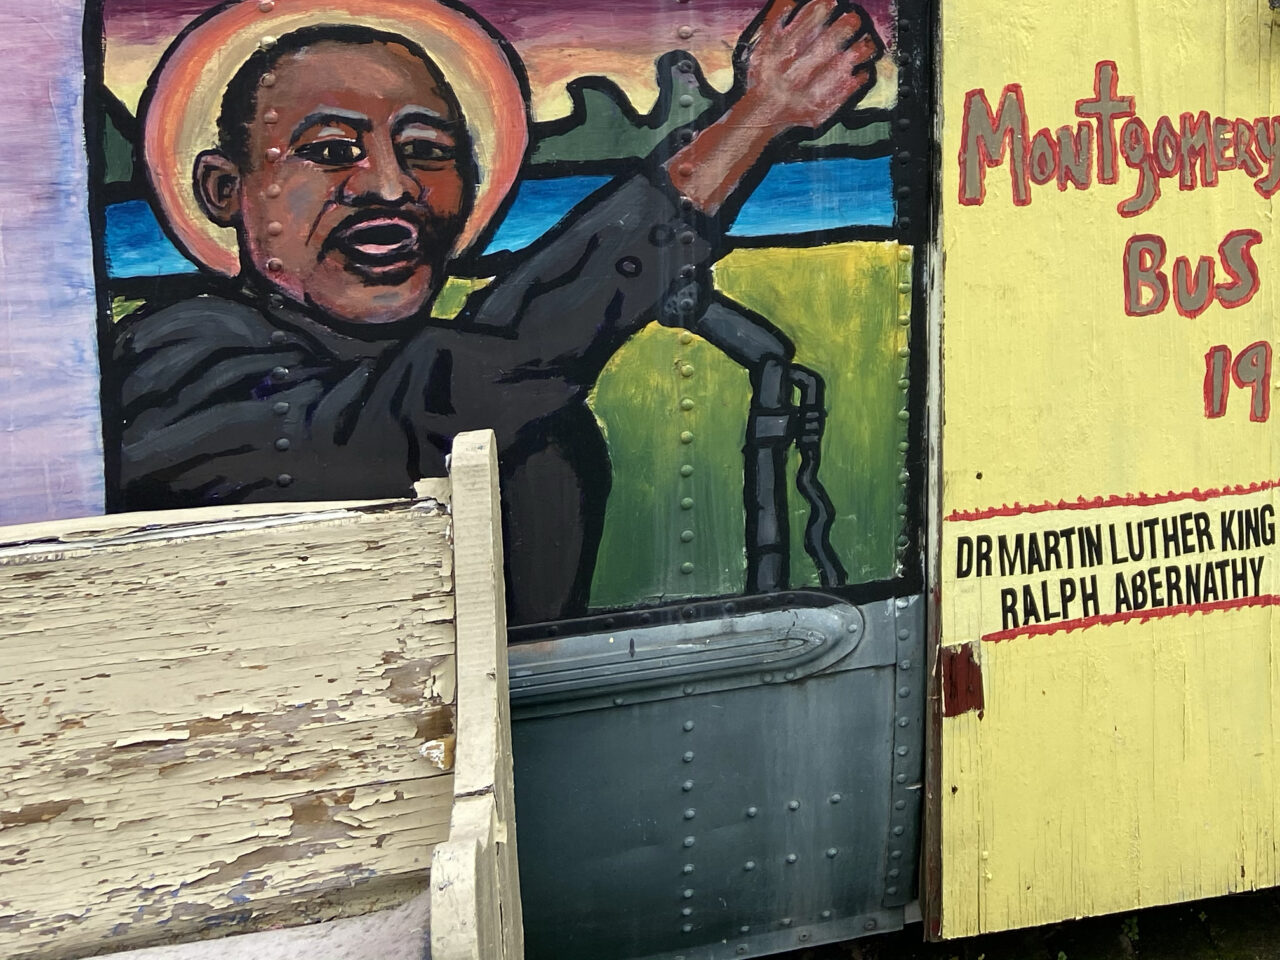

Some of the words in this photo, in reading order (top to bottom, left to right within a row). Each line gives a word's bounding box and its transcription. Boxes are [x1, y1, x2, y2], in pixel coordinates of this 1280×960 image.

[957, 535, 992, 578] DR
[998, 524, 1102, 577] MARTIN
[1109, 512, 1215, 565] LUTHER
[1221, 504, 1276, 552] KING
[1001, 572, 1099, 630] RALPH
[1116, 556, 1265, 614] ABERNATHY
